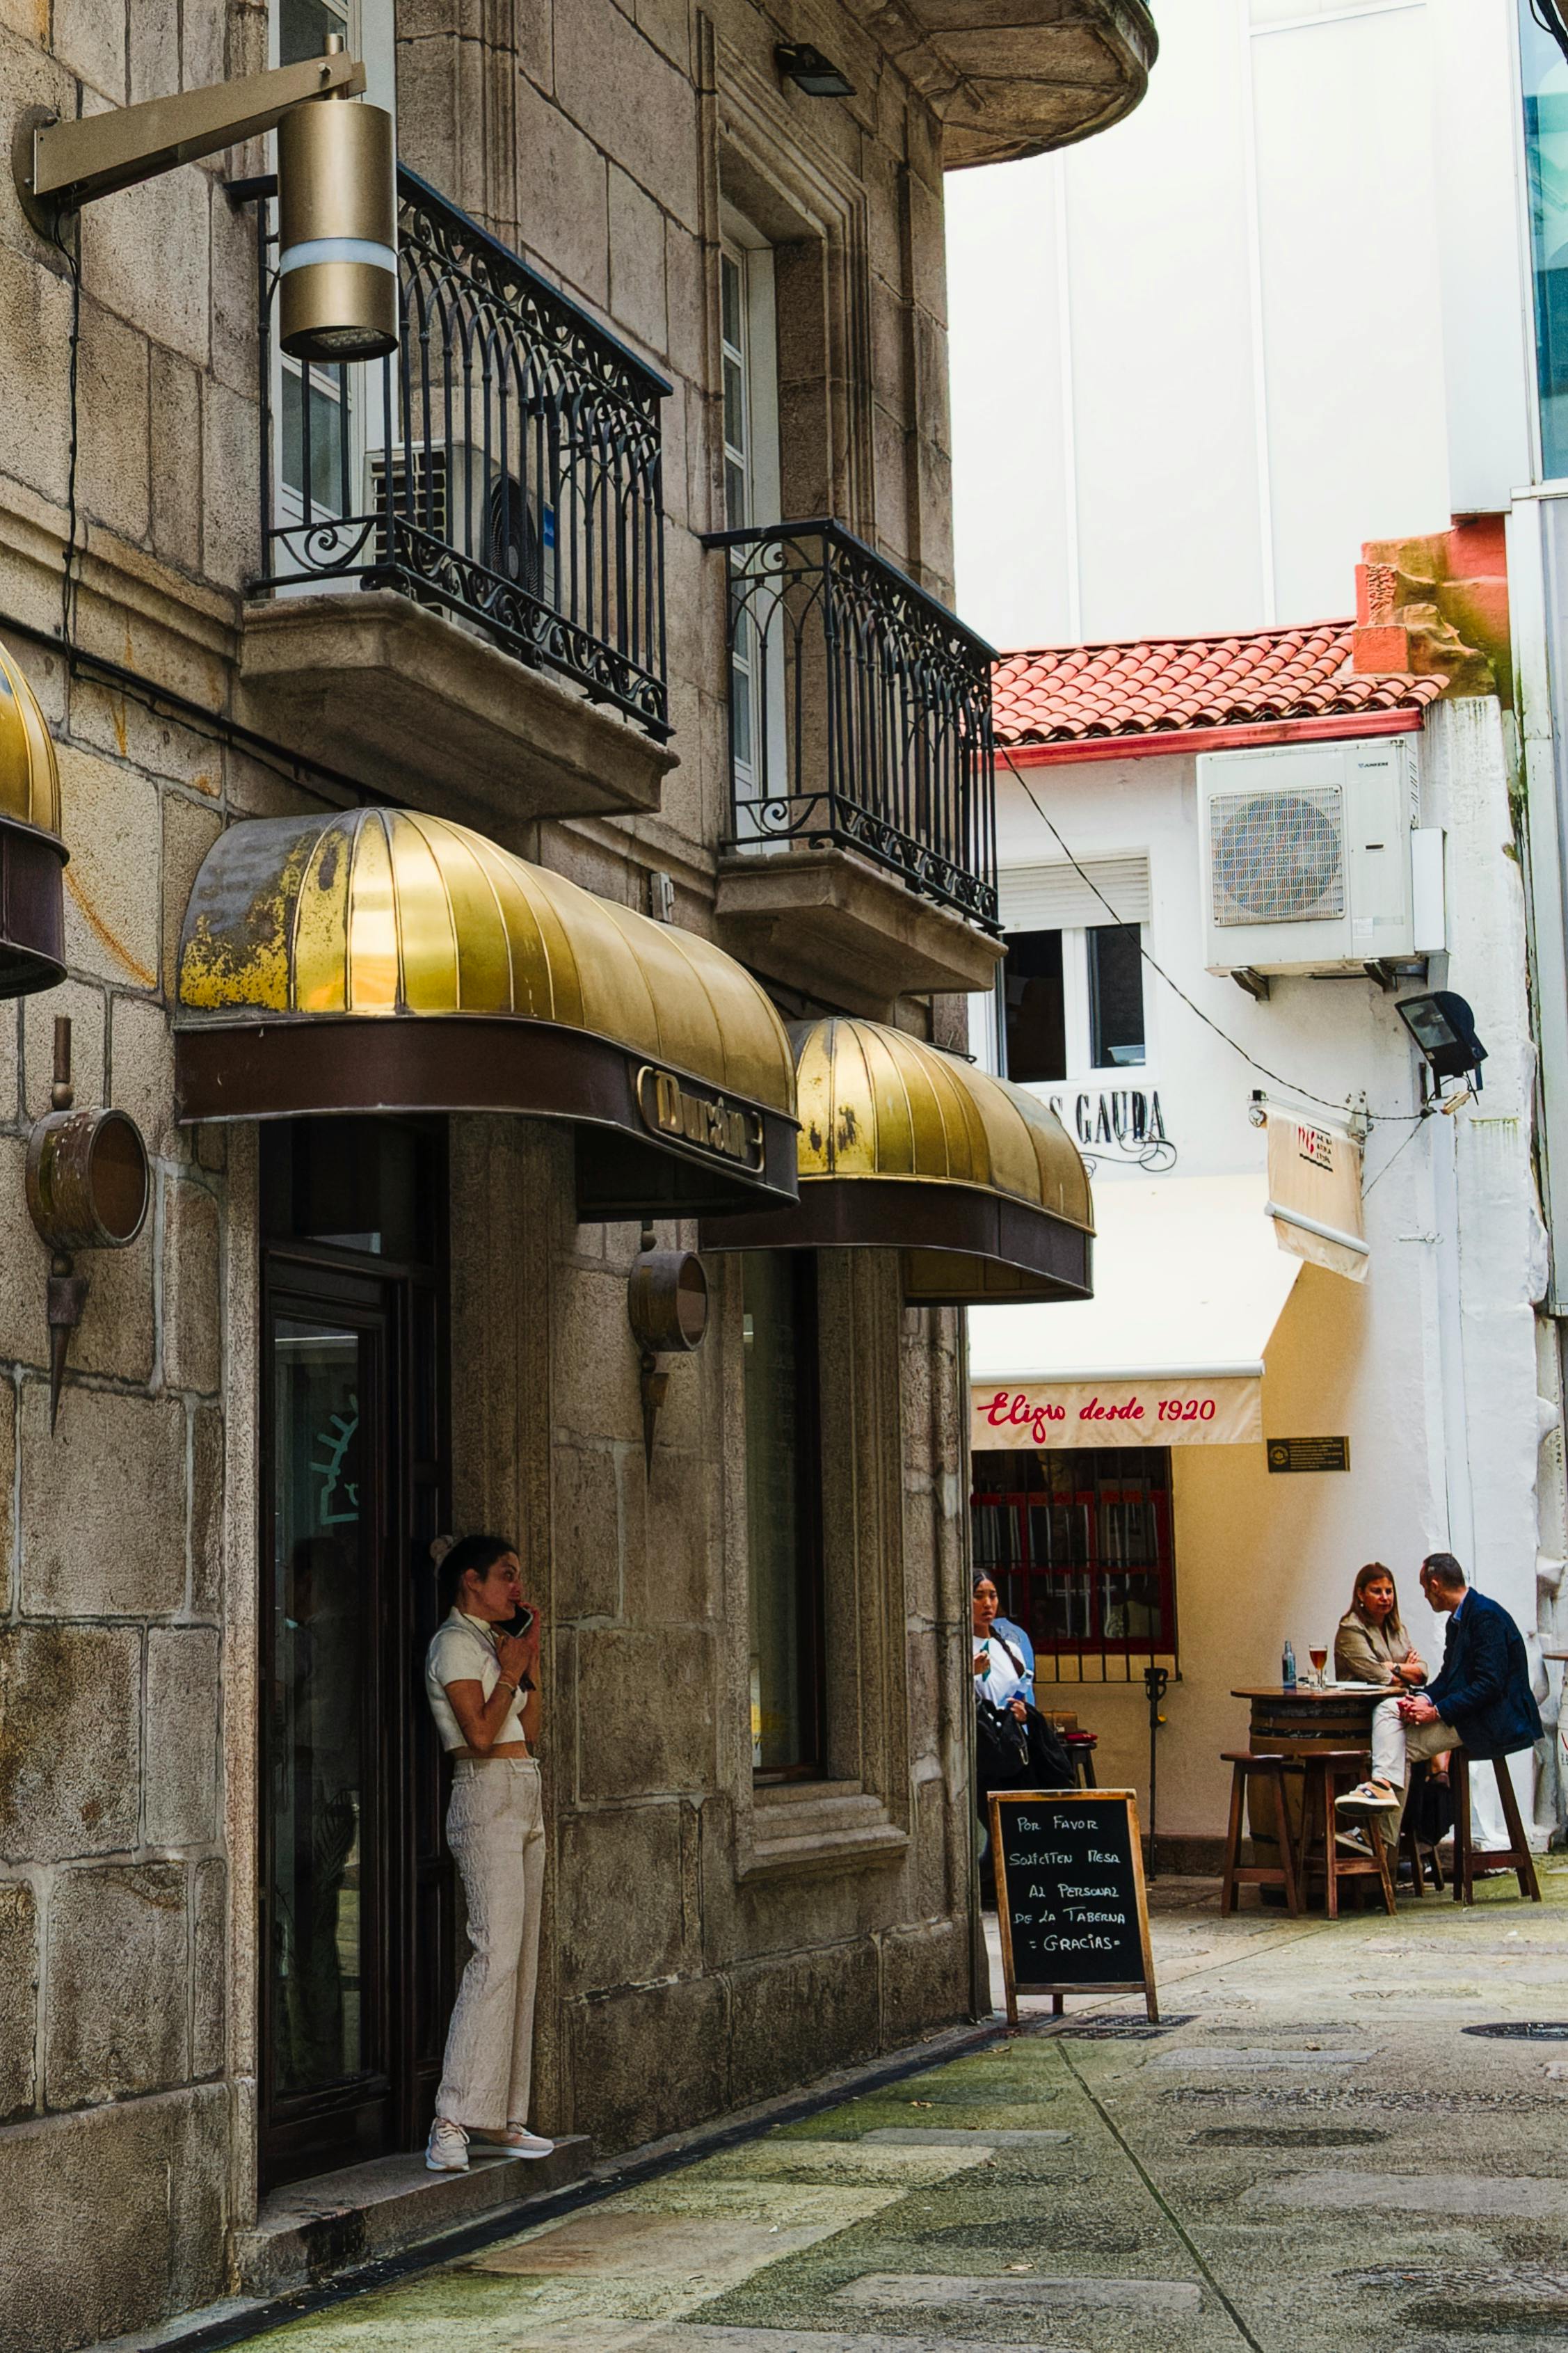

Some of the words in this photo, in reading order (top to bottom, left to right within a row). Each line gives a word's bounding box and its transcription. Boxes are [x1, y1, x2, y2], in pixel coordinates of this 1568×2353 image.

[1076, 1090, 1166, 1144] GAUDA
[977, 1391, 1066, 1444] Eligio
[1080, 1397, 1145, 1420] desde
[1158, 1399, 1216, 1421] 1920
[1014, 1913, 1032, 1924] DE
